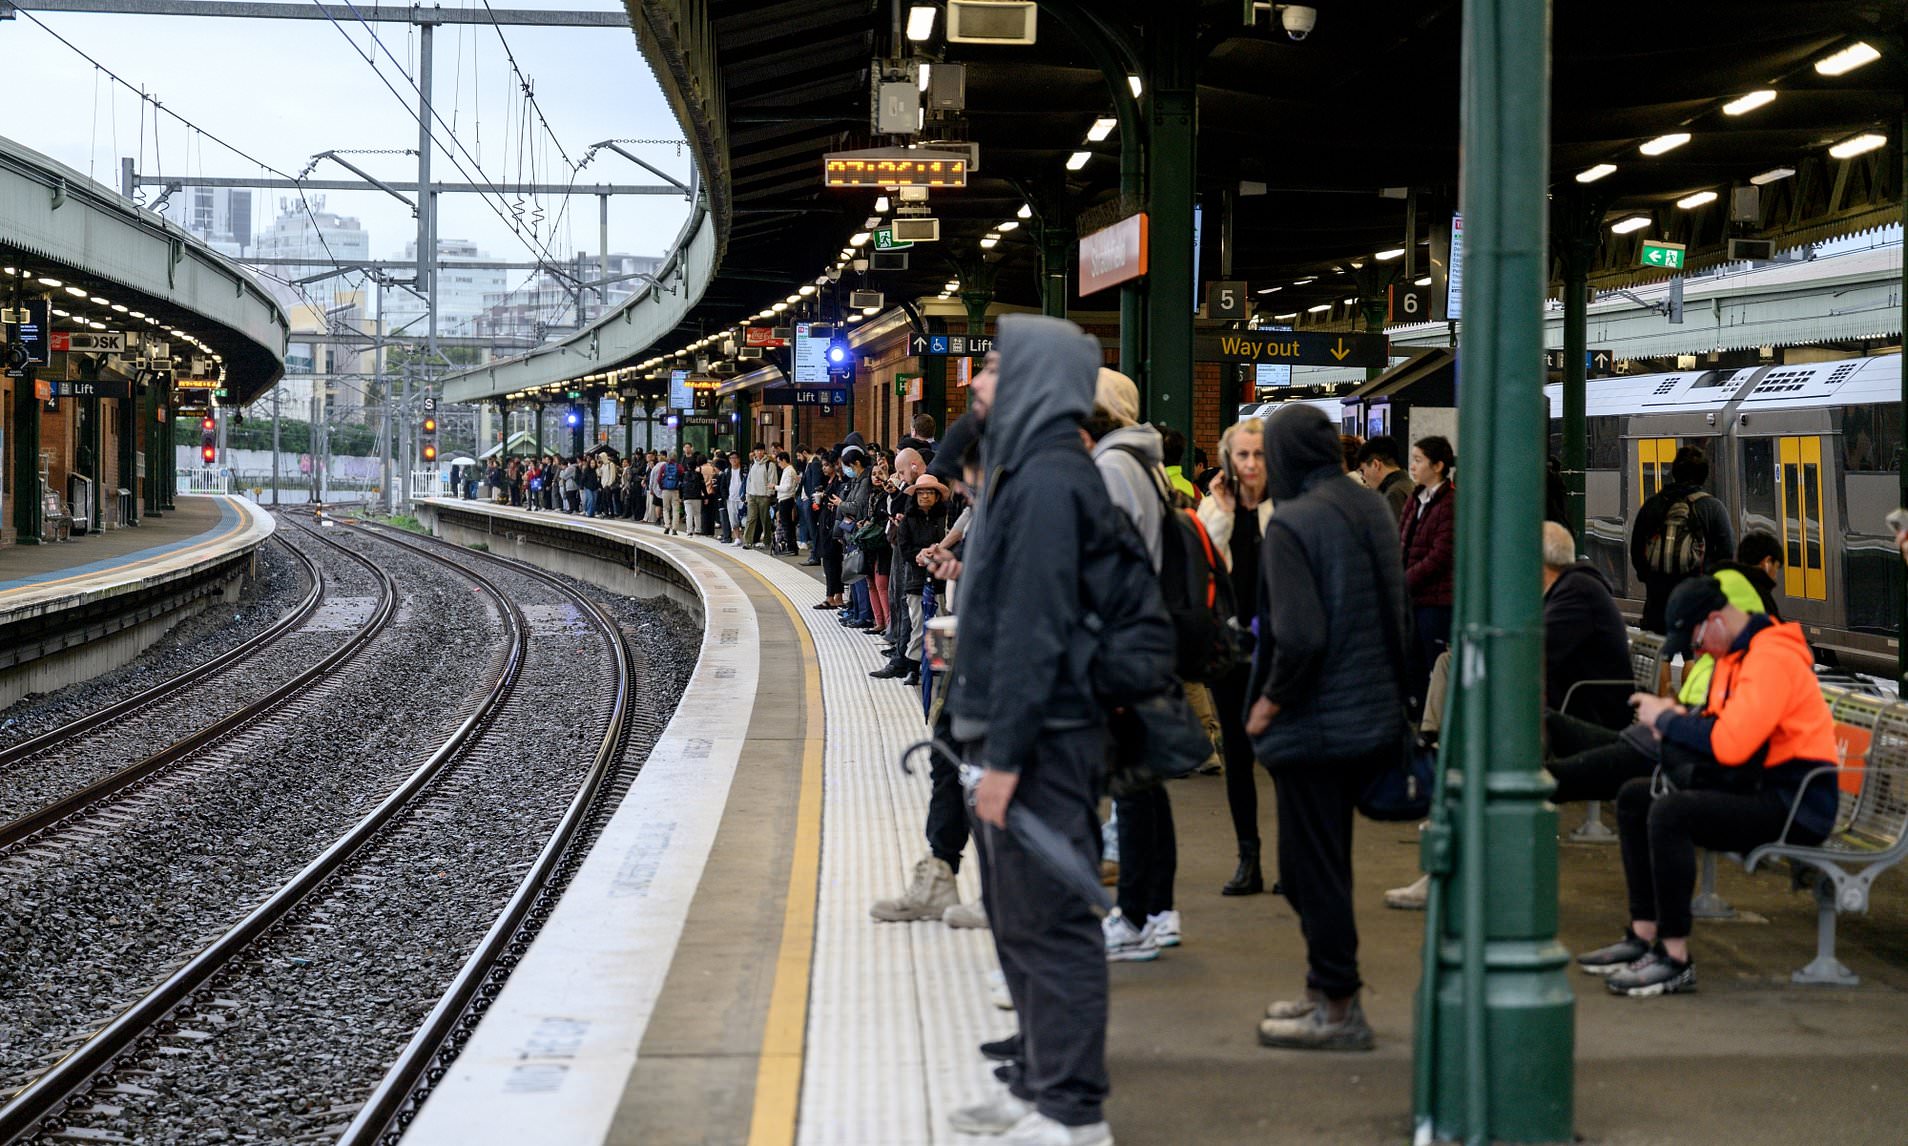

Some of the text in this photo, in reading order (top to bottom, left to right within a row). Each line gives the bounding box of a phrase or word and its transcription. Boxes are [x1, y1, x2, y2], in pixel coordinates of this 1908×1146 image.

[1220, 289, 1234, 310] 5
[1403, 293, 1418, 313] 6
[1221, 337, 1300, 360] Way out
[74, 384, 94, 394] Lift
[796, 391, 815, 402] Lift
[425, 398, 433, 409] S
[700, 399, 706, 407] 5
